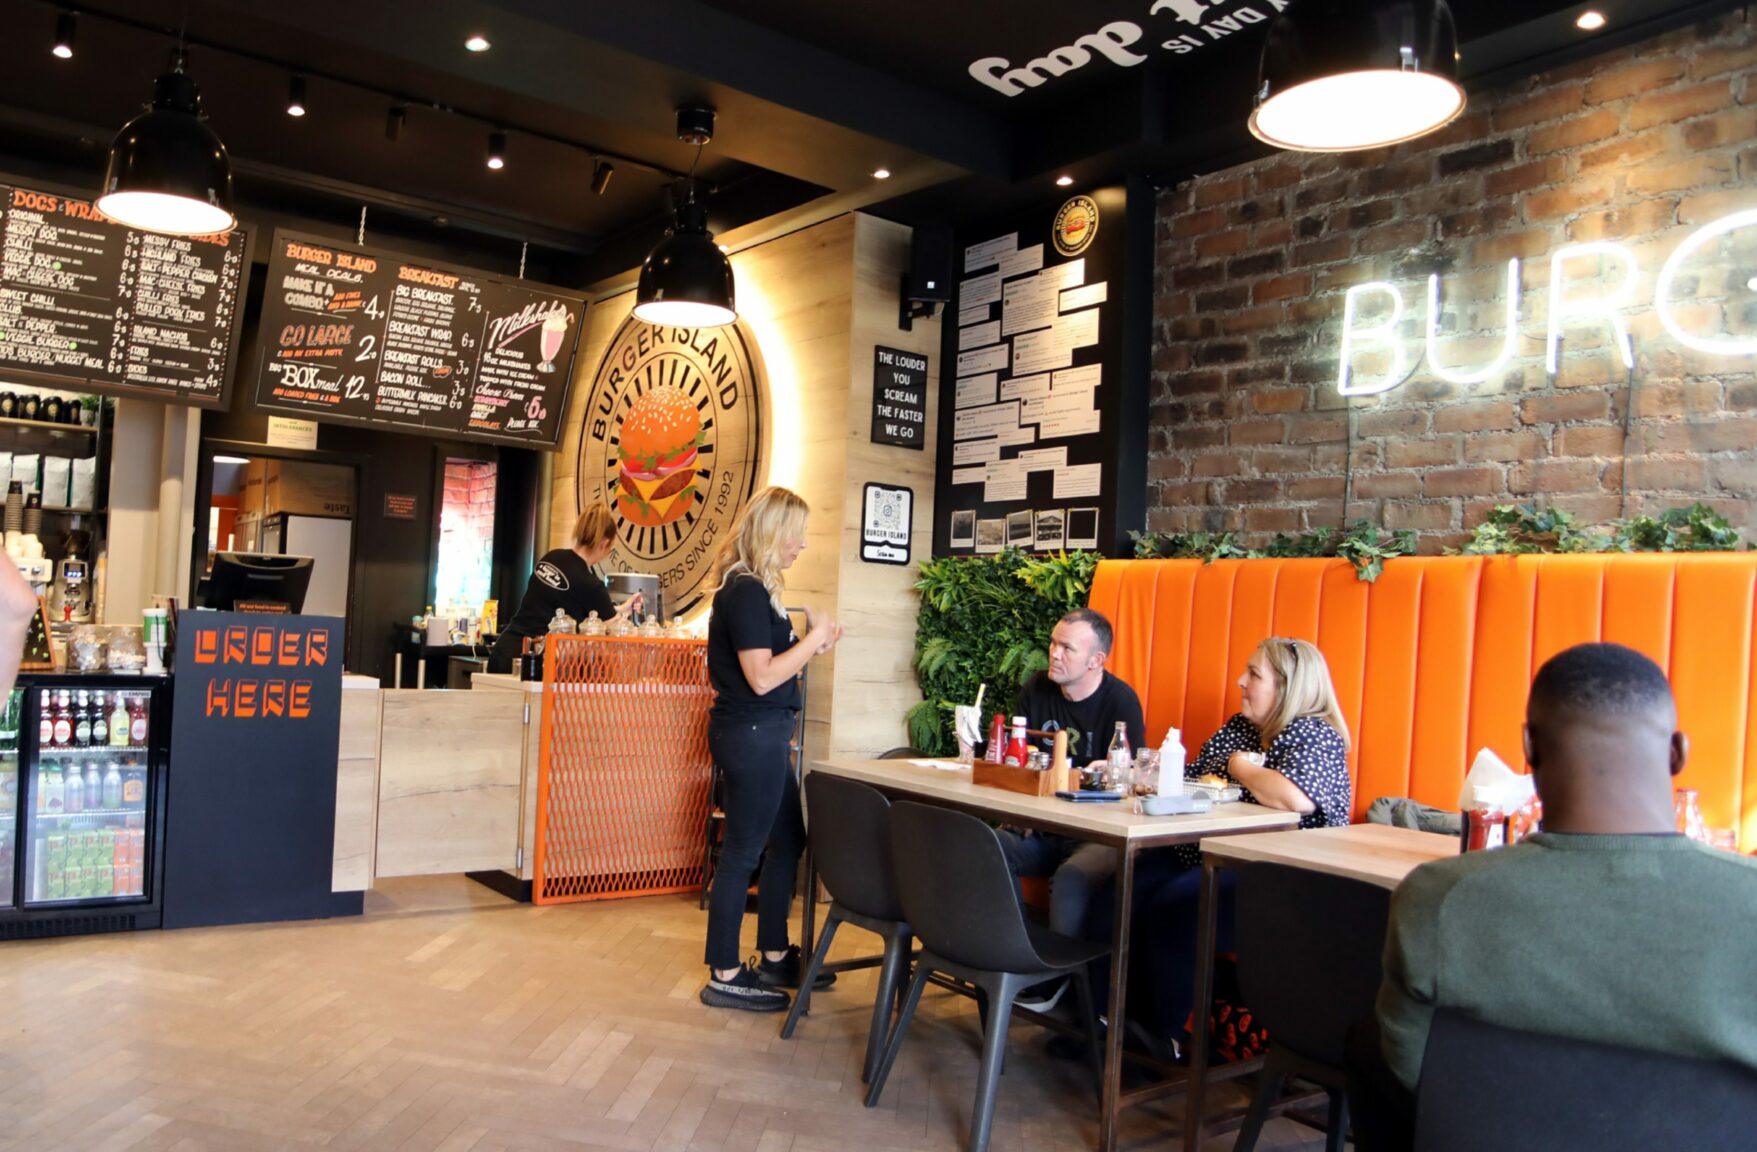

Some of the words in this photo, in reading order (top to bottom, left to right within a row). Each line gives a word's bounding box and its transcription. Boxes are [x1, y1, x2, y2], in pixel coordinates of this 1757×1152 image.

[1200, 6, 1269, 40] DAY
[1161, 34, 1206, 54] IS
[968, 21, 1148, 97] day
[64, 200, 117, 224] WRA
[286, 243, 332, 265] BURGER
[336, 254, 377, 273] ISLAND
[282, 275, 314, 293] MAKE
[314, 280, 326, 294] IT
[398, 266, 460, 289] BREAKFAST
[279, 324, 306, 347] GO
[306, 324, 355, 347] LARGE
[388, 320, 431, 337] BREAKFAST
[384, 350, 421, 364] BREAKFAST
[879, 351, 893, 364] THE
[895, 355, 926, 371] LOUDER
[281, 363, 320, 389] BOX
[380, 371, 405, 385] BACON
[592, 325, 665, 441] BURGER
[671, 326, 738, 410] ISLAND
[893, 372, 911, 385] YOU
[884, 388, 918, 404] SCREAM
[877, 404, 892, 418] THE
[894, 407, 923, 423] FASTER
[885, 423, 898, 436] WE
[900, 426, 914, 438] GO
[685, 518, 719, 572] SINCE
[714, 470, 734, 515] 1992
[866, 528, 887, 538] BURGER
[888, 531, 907, 540] ISLAND
[194, 624, 329, 667] ORDER
[206, 677, 313, 719] HERE
